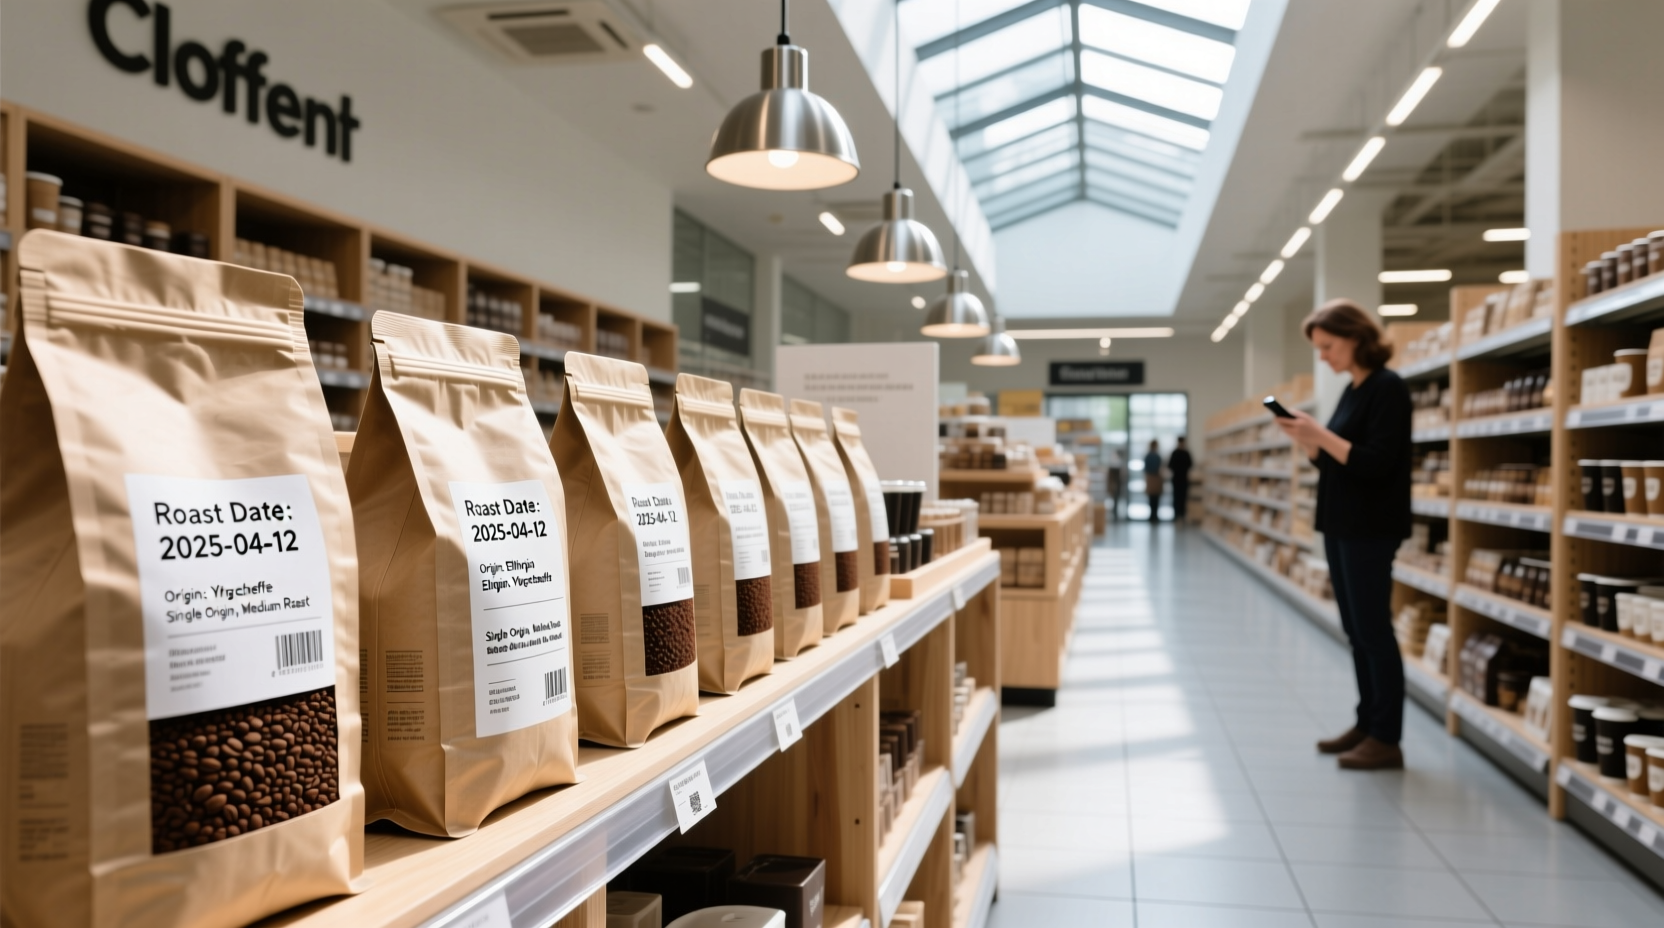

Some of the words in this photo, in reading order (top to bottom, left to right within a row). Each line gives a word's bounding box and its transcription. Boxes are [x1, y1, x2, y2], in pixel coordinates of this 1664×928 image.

[87, 0, 360, 162] Cloffent
[154, 502, 224, 525] Roast
[229, 501, 293, 523] Date:
[503, 498, 541, 515] Date:
[471, 520, 547, 543] 2025-04-12
[159, 529, 299, 561] 2025-04-12
[164, 588, 208, 605] Origin:
[166, 608, 202, 623] Single
[205, 606, 239, 621] Origin,
